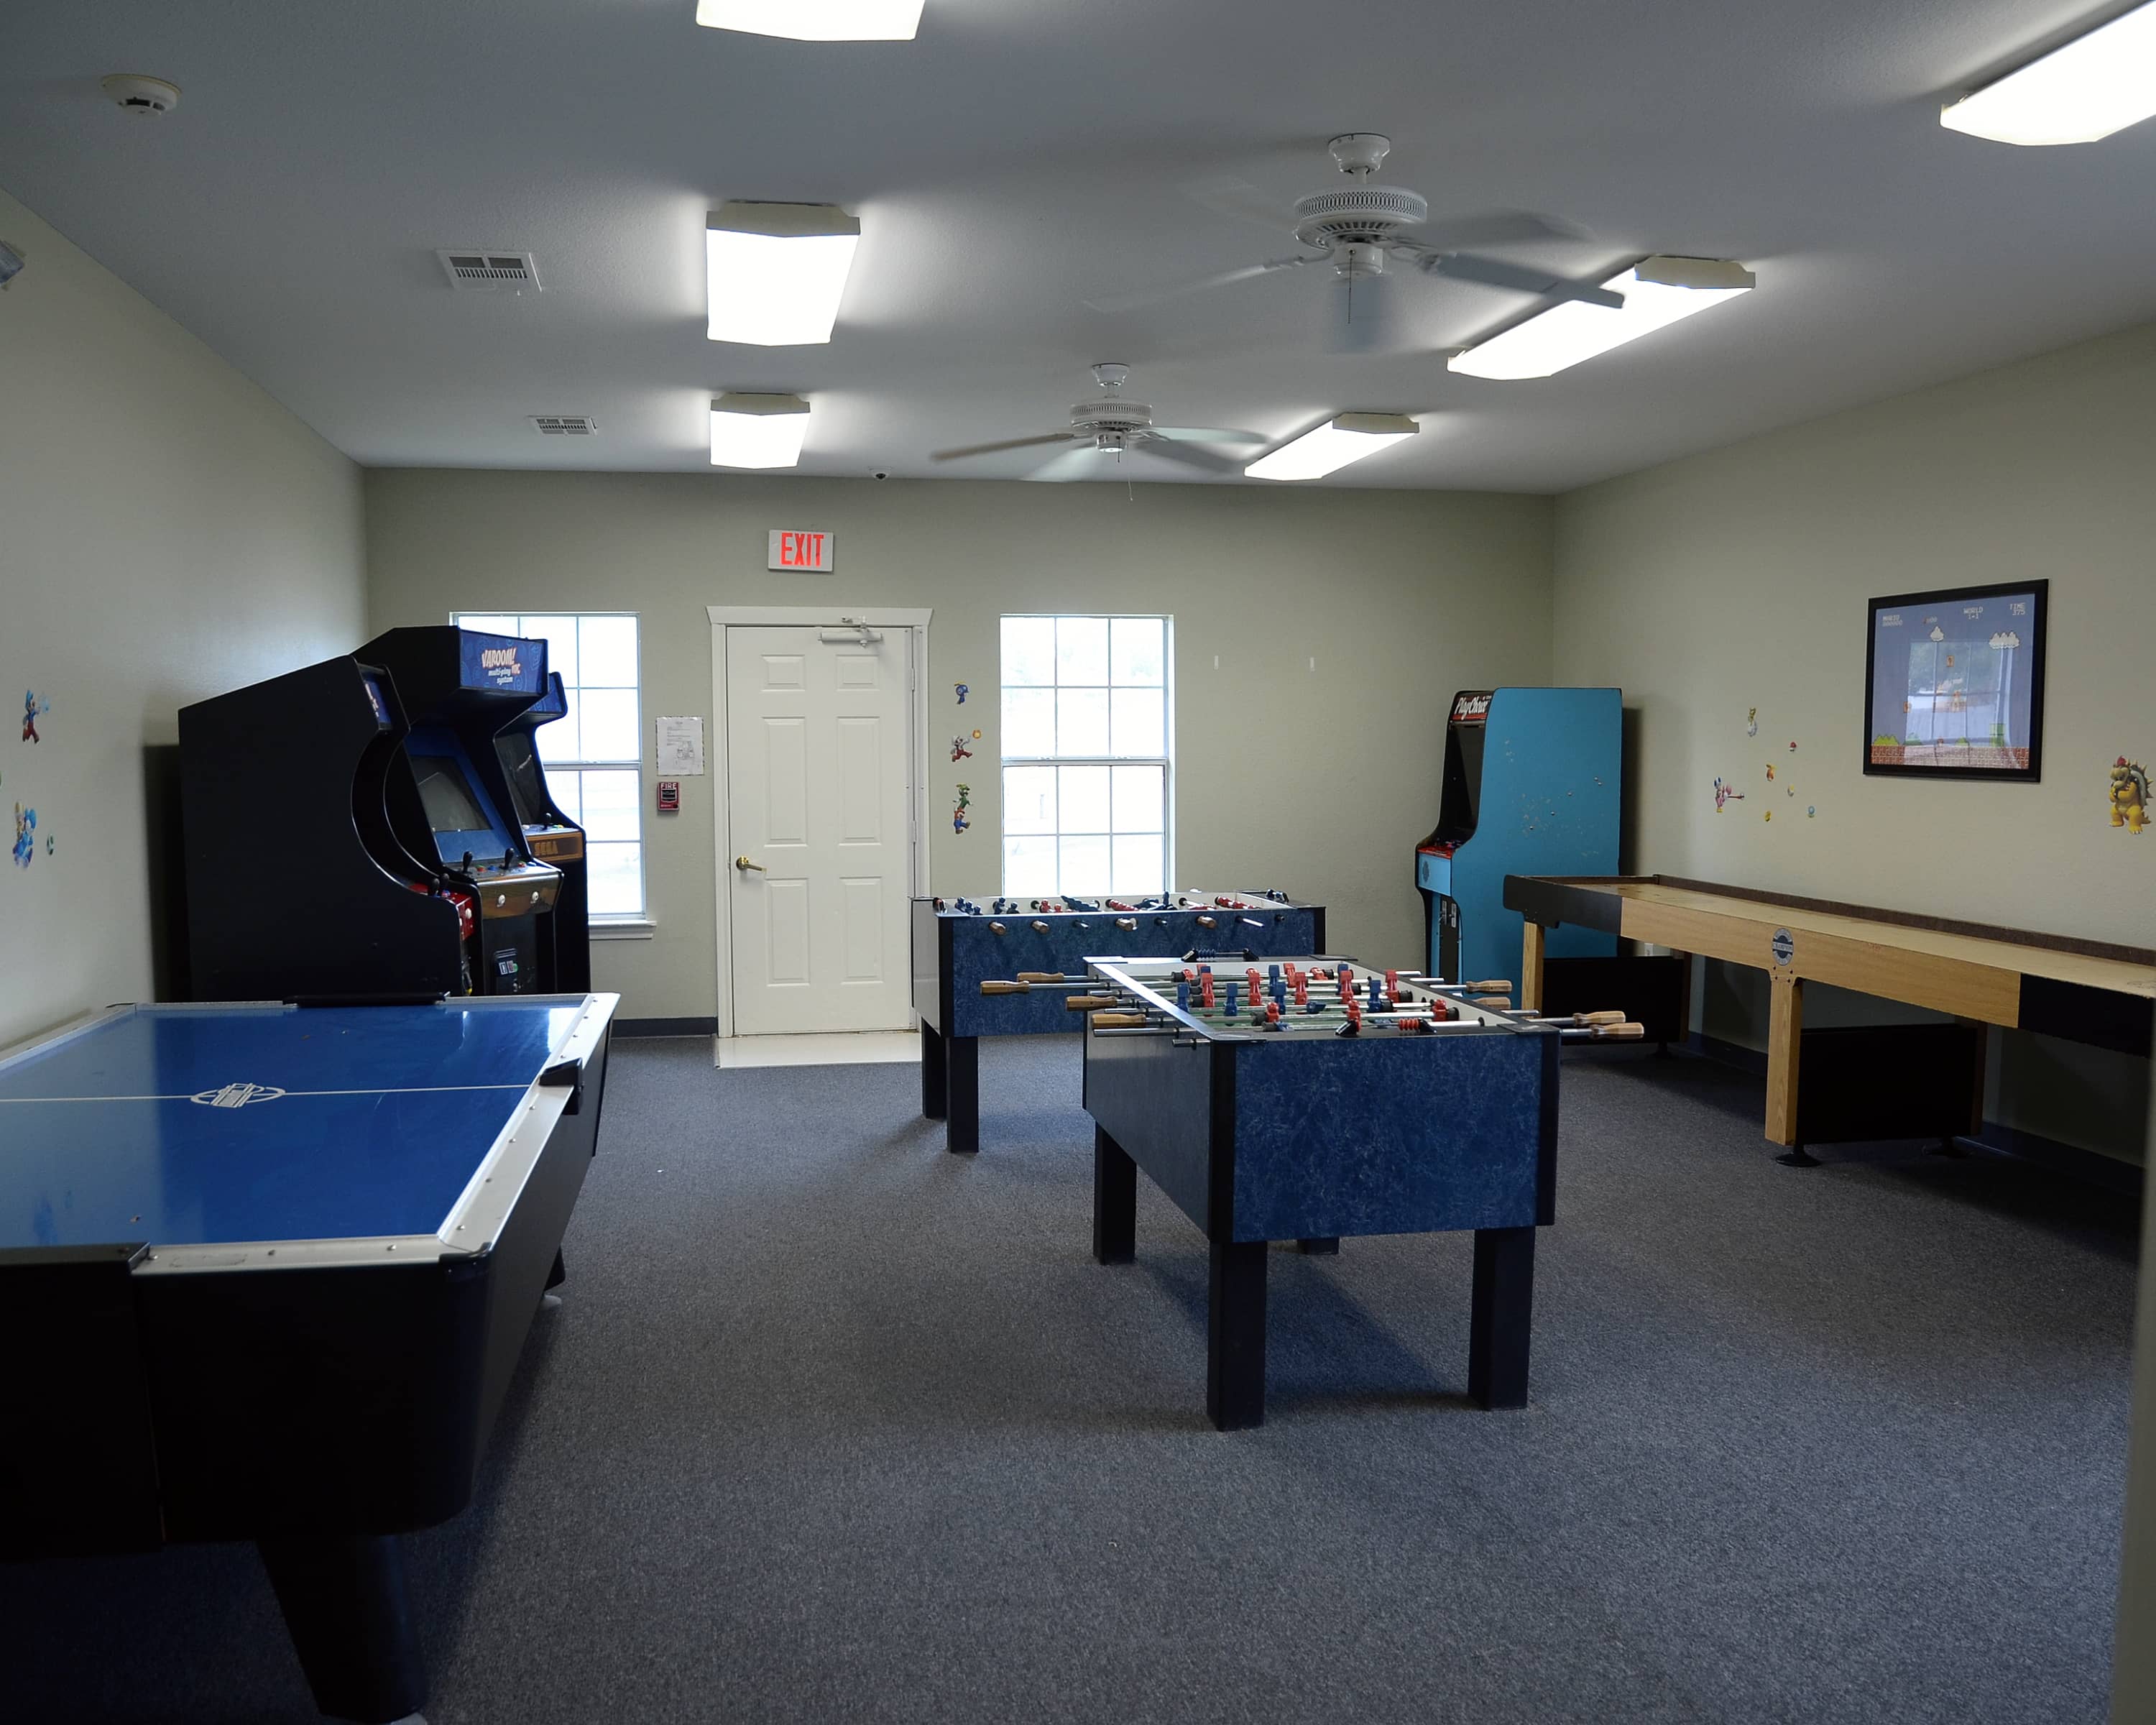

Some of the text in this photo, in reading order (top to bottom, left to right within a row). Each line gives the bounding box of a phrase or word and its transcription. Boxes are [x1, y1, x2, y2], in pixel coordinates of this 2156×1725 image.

[780, 533, 824, 567] EXIT
[482, 647, 517, 668] VAROOM!
[534, 840, 558, 856] SEGA
